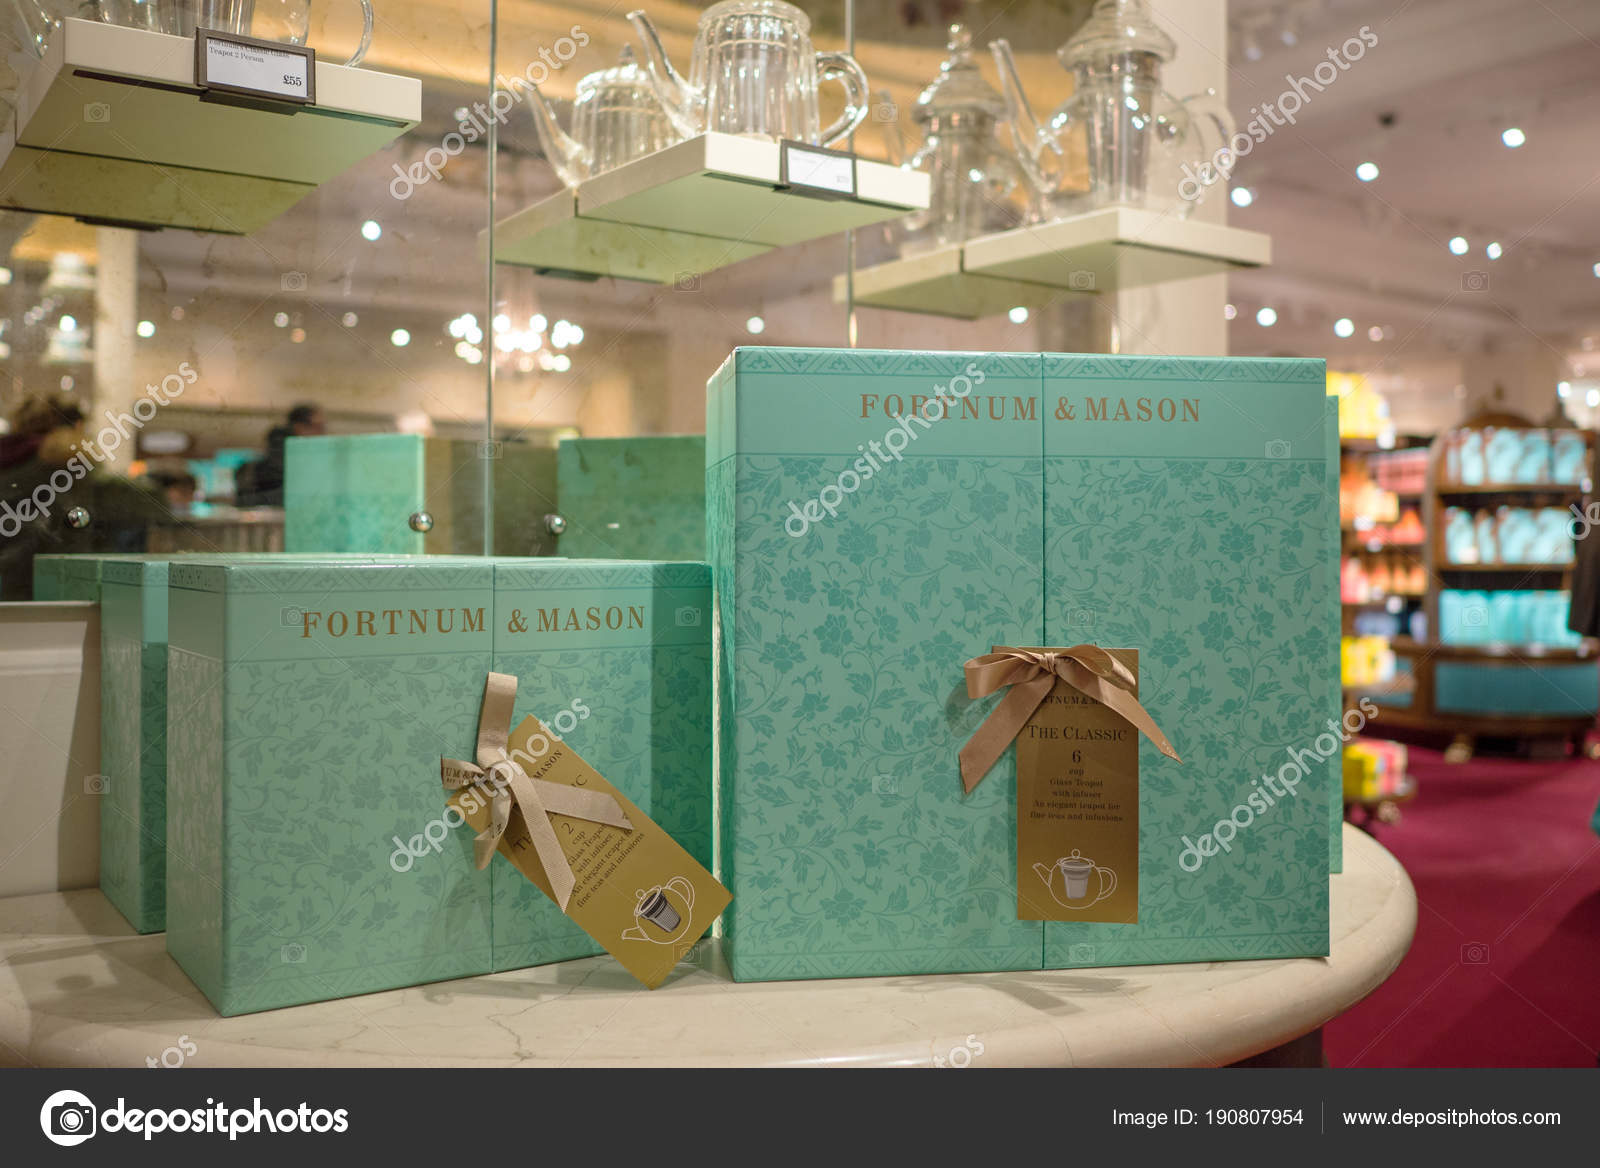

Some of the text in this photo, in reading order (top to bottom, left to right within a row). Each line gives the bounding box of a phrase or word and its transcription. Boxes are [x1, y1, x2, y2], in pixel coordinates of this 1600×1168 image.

[209, 46, 233, 57] Teapot
[240, 53, 265, 63] Person
[283, 74, 302, 86] £55
[859, 393, 1201, 422] FORTNUM & MASON
[300, 605, 645, 638] FORTNUM & MASON
[1072, 750, 1081, 763] 6
[1068, 768, 1084, 777] cup
[1076, 779, 1103, 789] Teapot
[561, 822, 574, 835] 2
[572, 831, 585, 845] cup
[576, 857, 591, 873] with
[582, 859, 605, 884] elegant
[605, 836, 625, 860] teapot
[577, 893, 591, 907] fine
[590, 878, 604, 893] teas
[604, 862, 617, 879] and
